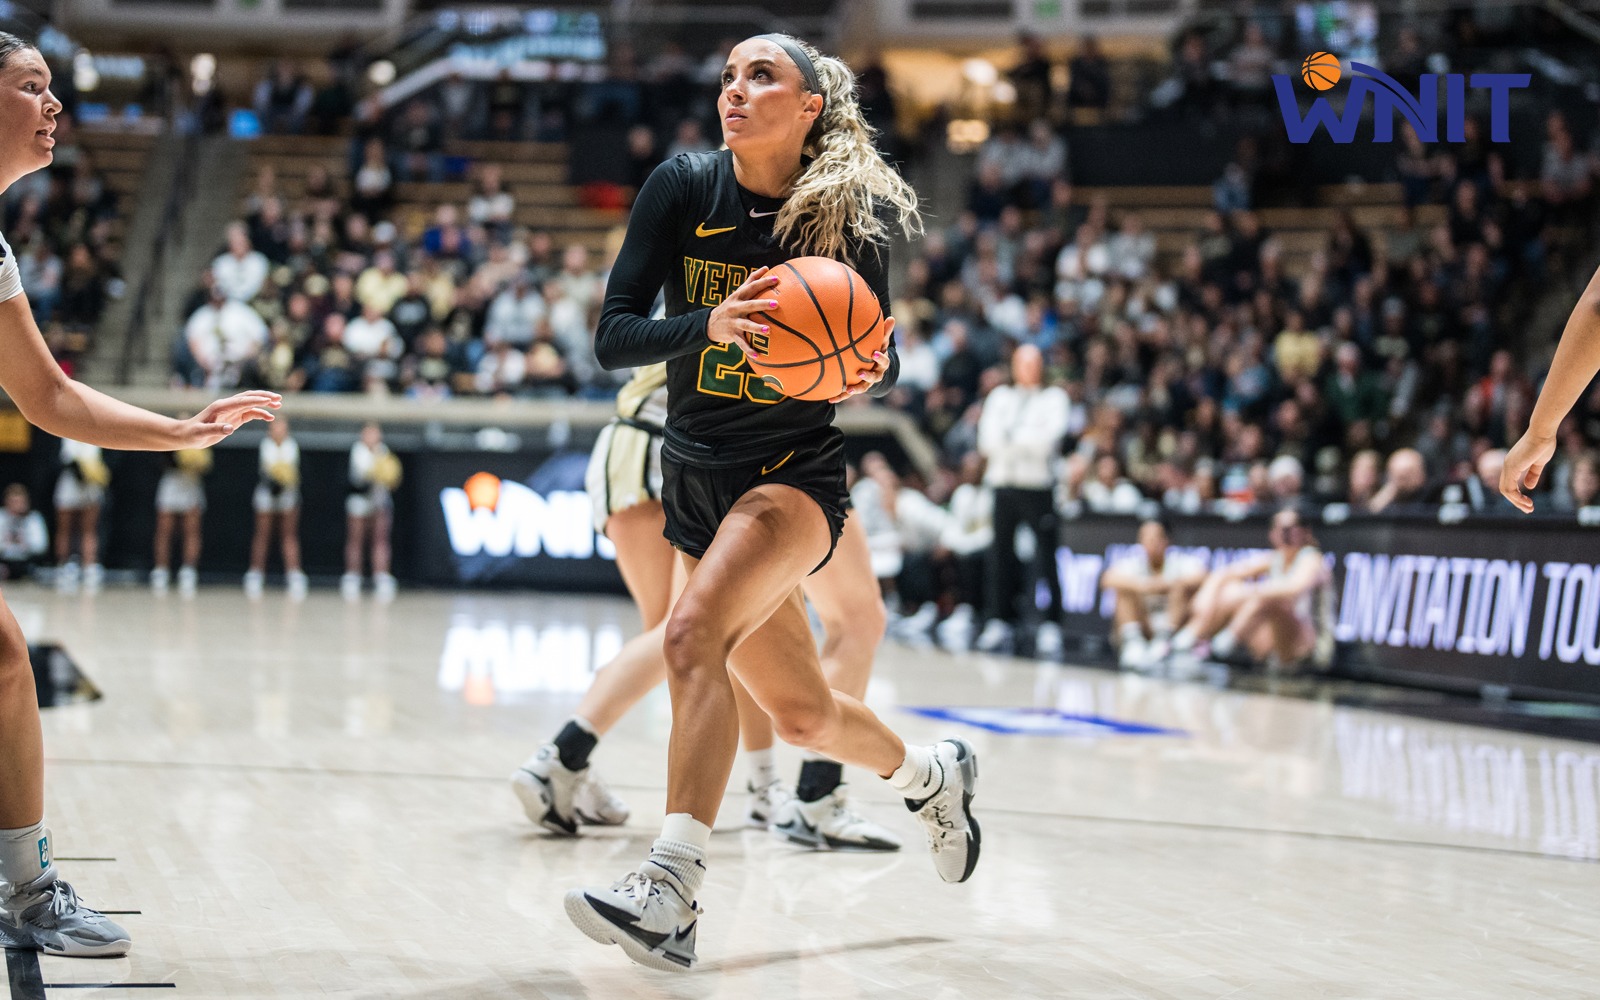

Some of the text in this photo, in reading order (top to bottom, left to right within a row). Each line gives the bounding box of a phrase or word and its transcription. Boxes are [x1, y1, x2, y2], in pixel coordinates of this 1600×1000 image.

[683, 255, 757, 307] VER
[439, 478, 617, 560] WNI
[1334, 551, 1538, 659] INVITATION
